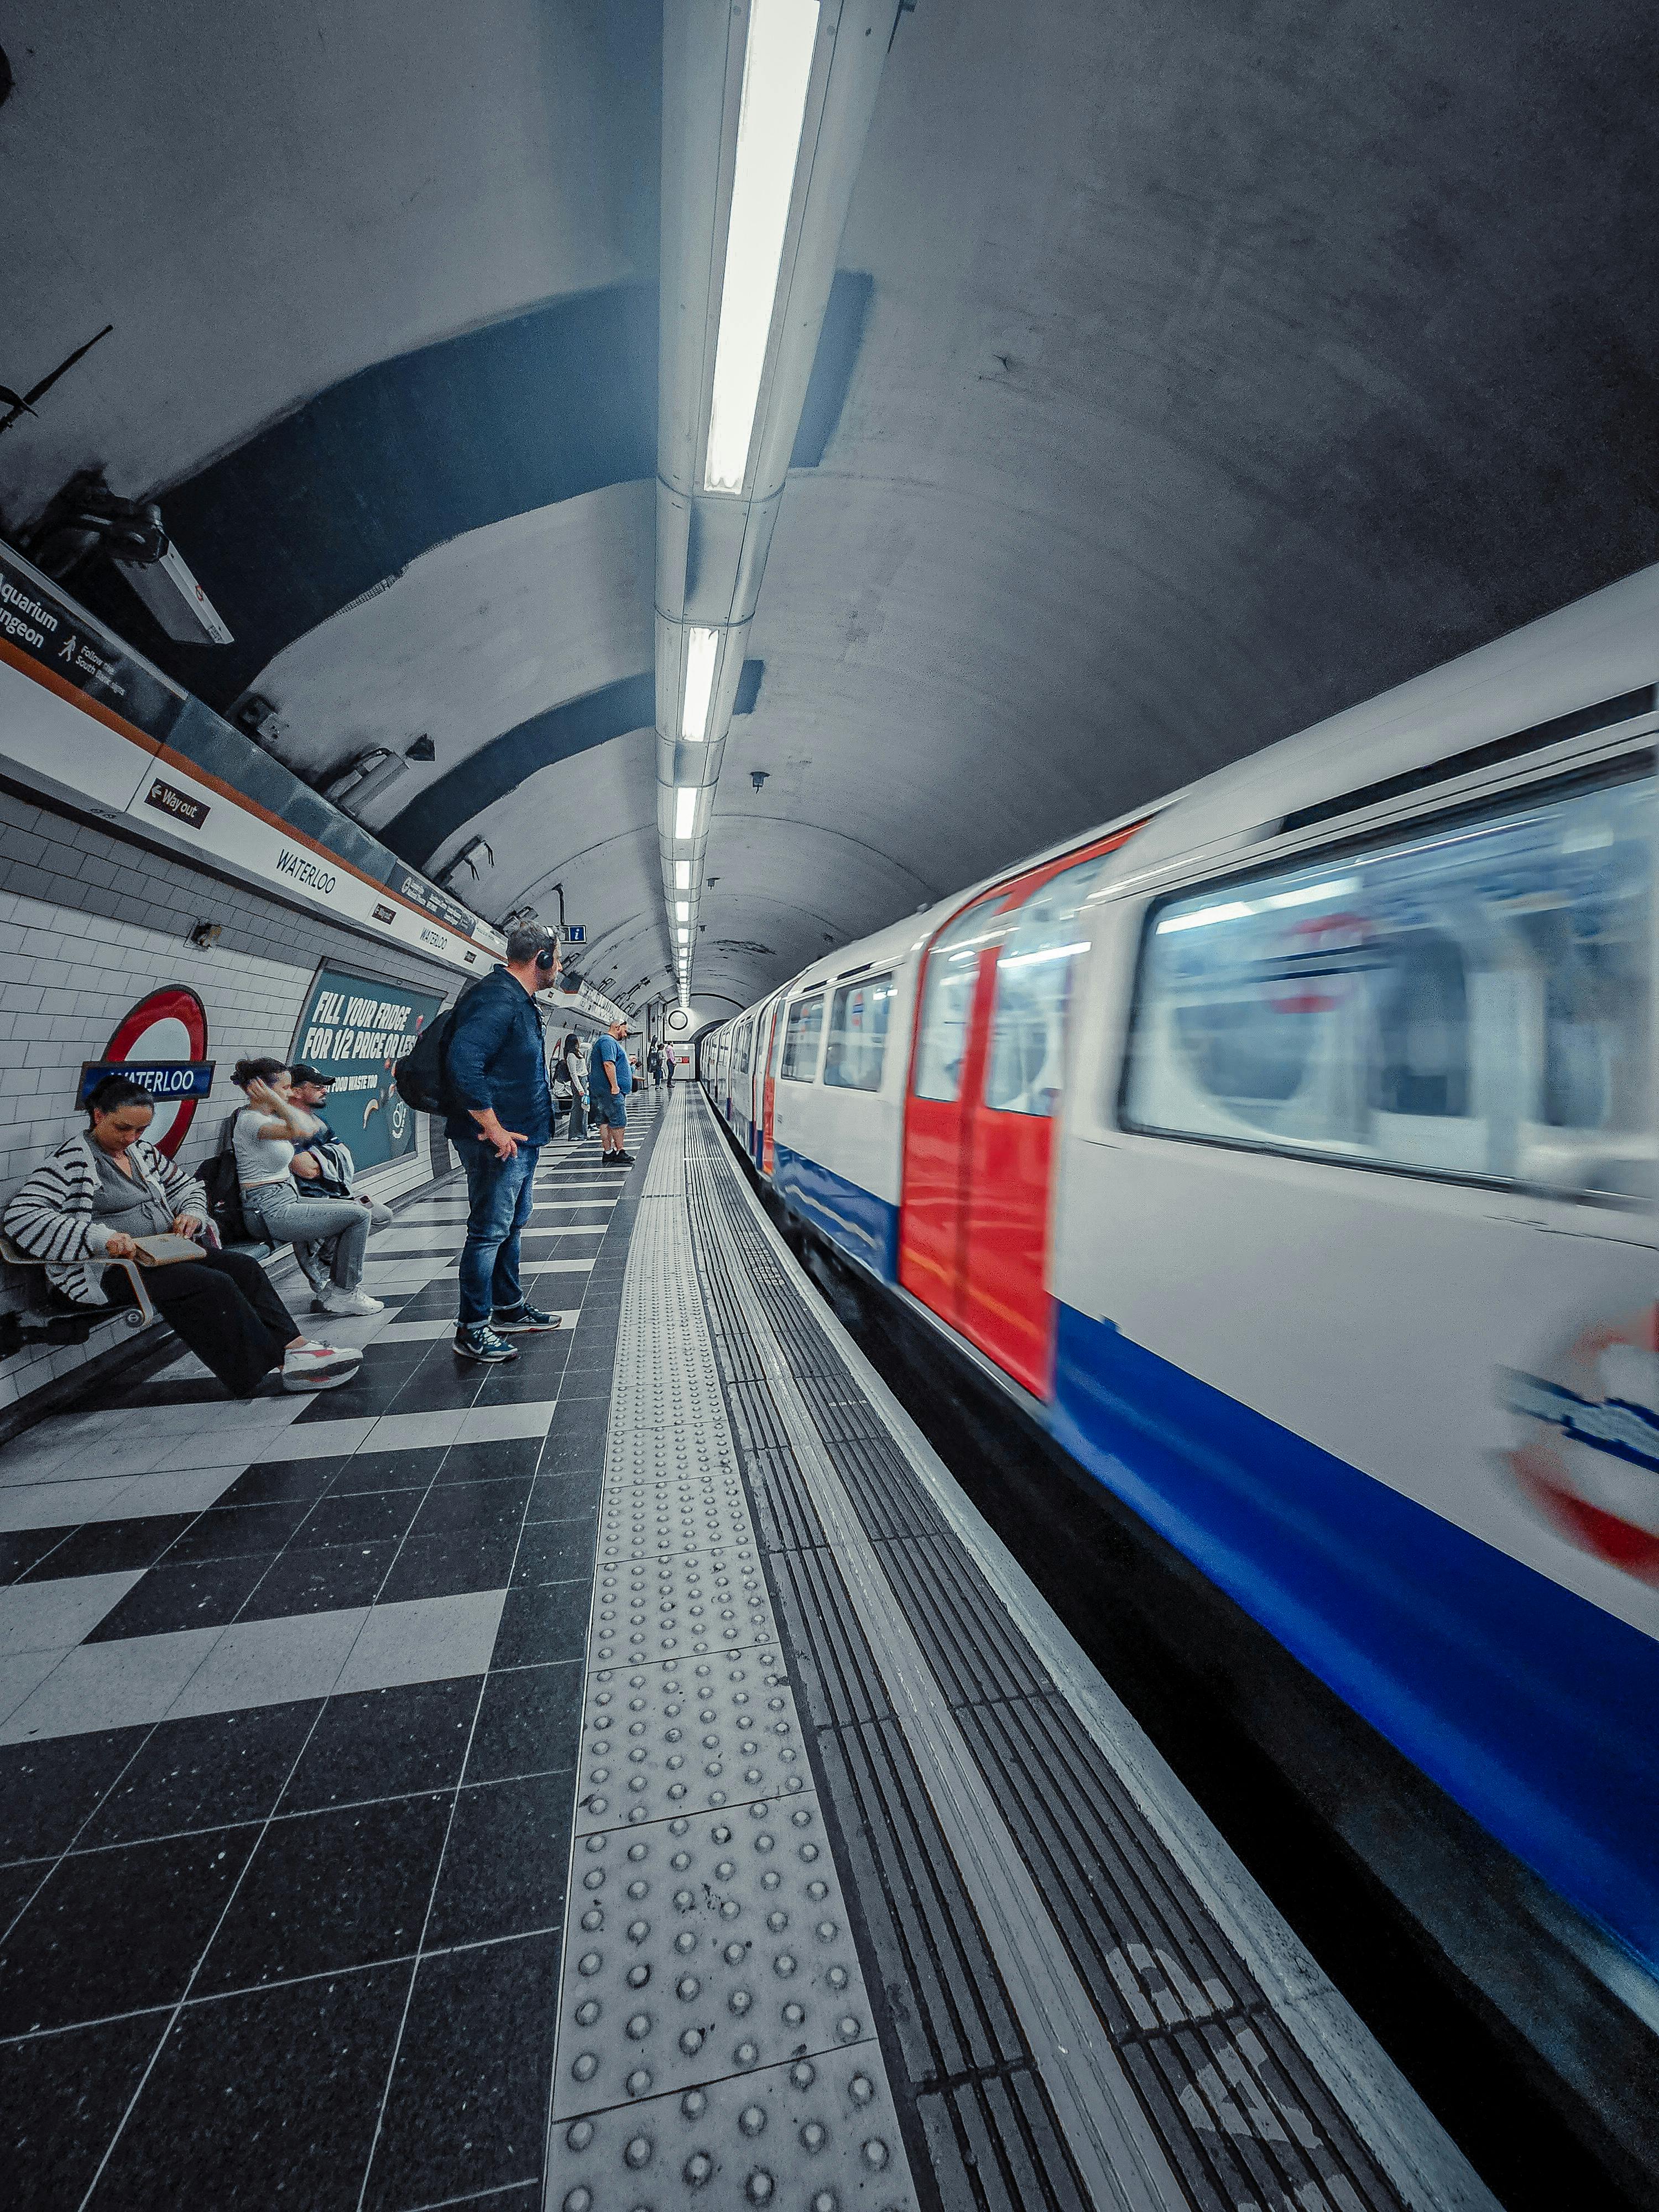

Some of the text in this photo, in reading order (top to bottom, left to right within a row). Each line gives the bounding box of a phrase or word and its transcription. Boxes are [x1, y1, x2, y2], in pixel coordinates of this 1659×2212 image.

[76, 656, 96, 675] South
[81, 645, 103, 665] Follow
[163, 789, 197, 817] Way out
[276, 848, 336, 894] WATERLOO
[312, 991, 412, 1031] FILL YOUR FRIDGE
[301, 1027, 333, 1060] FOR
[331, 1028, 354, 1061] 1/2
[351, 1031, 387, 1059] PRICE
[383, 1032, 399, 1058] OR
[331, 1076, 348, 1093] FOOD
[348, 1075, 368, 1091] WASTE
